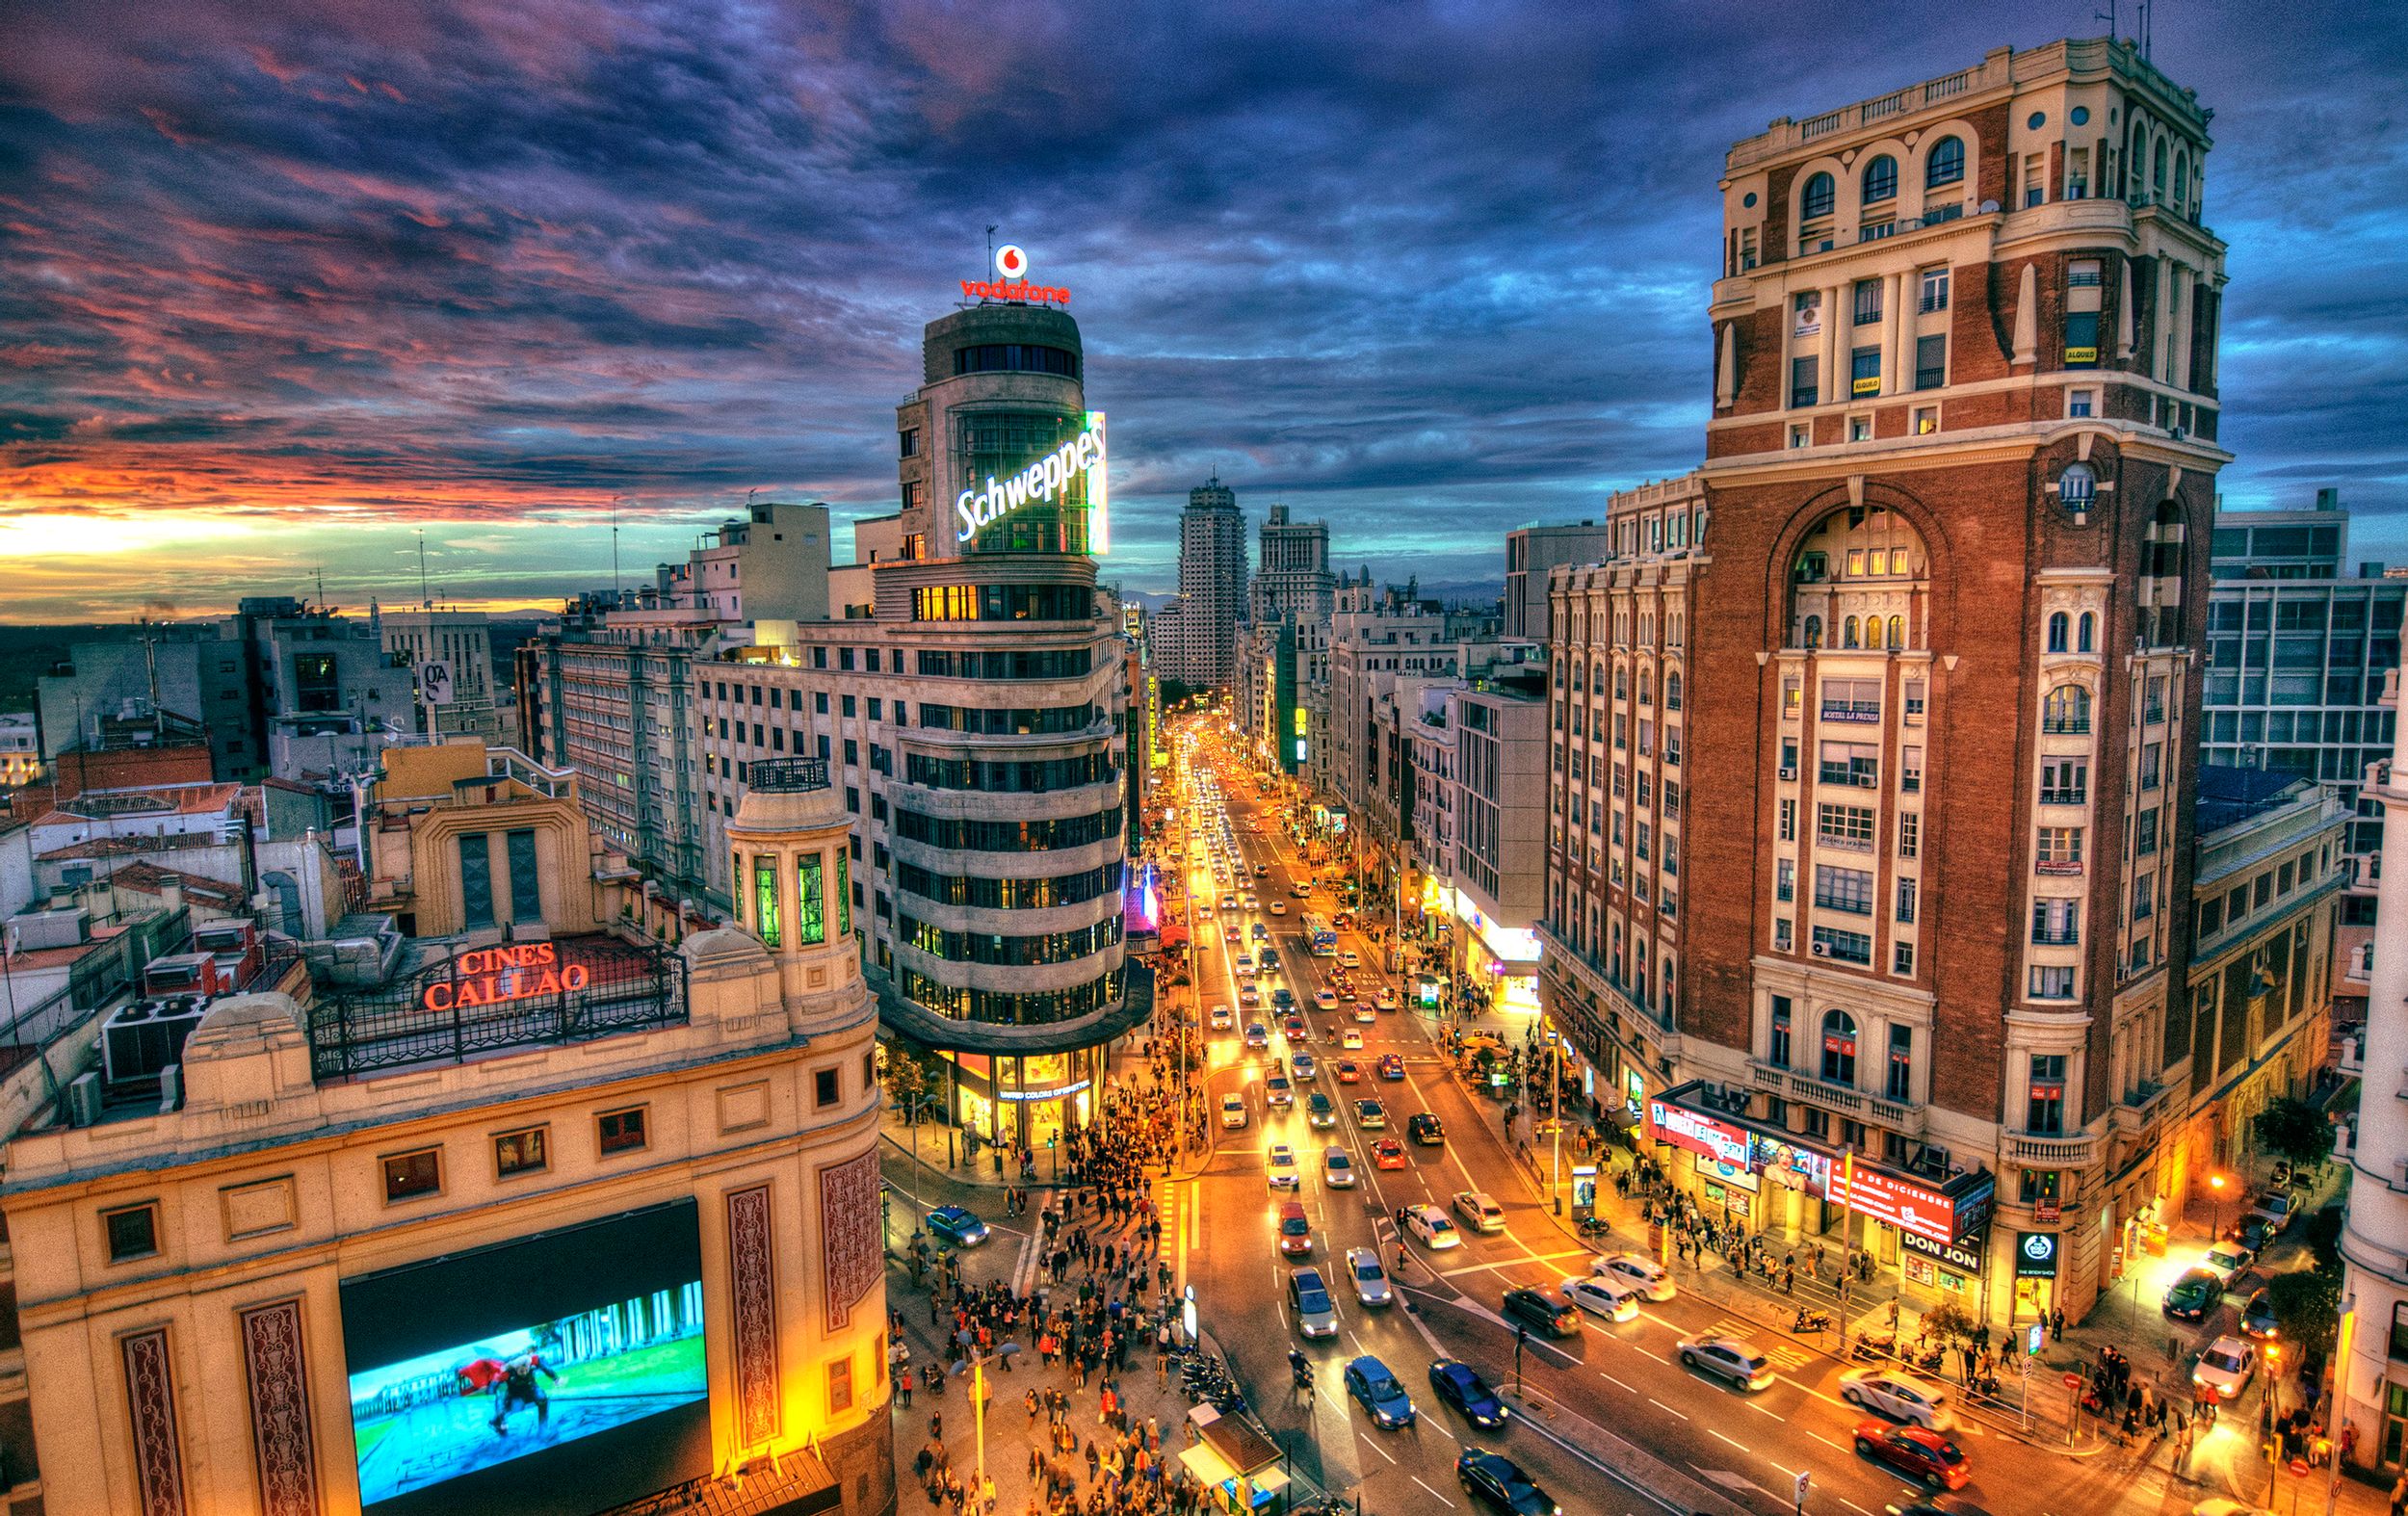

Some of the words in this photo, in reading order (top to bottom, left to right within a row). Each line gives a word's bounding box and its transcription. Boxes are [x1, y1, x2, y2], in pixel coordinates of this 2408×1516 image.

[960, 277, 1071, 304] vodafone
[1855, 380, 1878, 389] ALQUILO
[955, 420, 1105, 542] Schweppes
[1823, 711, 1845, 719] HOSTAL
[1855, 712, 1878, 721] PRENSA
[1131, 823, 1139, 853] REX
[458, 942, 557, 976] CINES
[424, 964, 589, 1011] CALLAO
[1000, 1090, 1024, 1099] UNITED
[1025, 1089, 1053, 1100] COLORS
[1868, 1174, 1882, 1186] DE
[1887, 1182, 1950, 1209] DICIEMBRE
[1904, 1232, 1941, 1255] DON
[1944, 1246, 1977, 1268] JON
[1765, 1346, 1813, 1372] BUS
